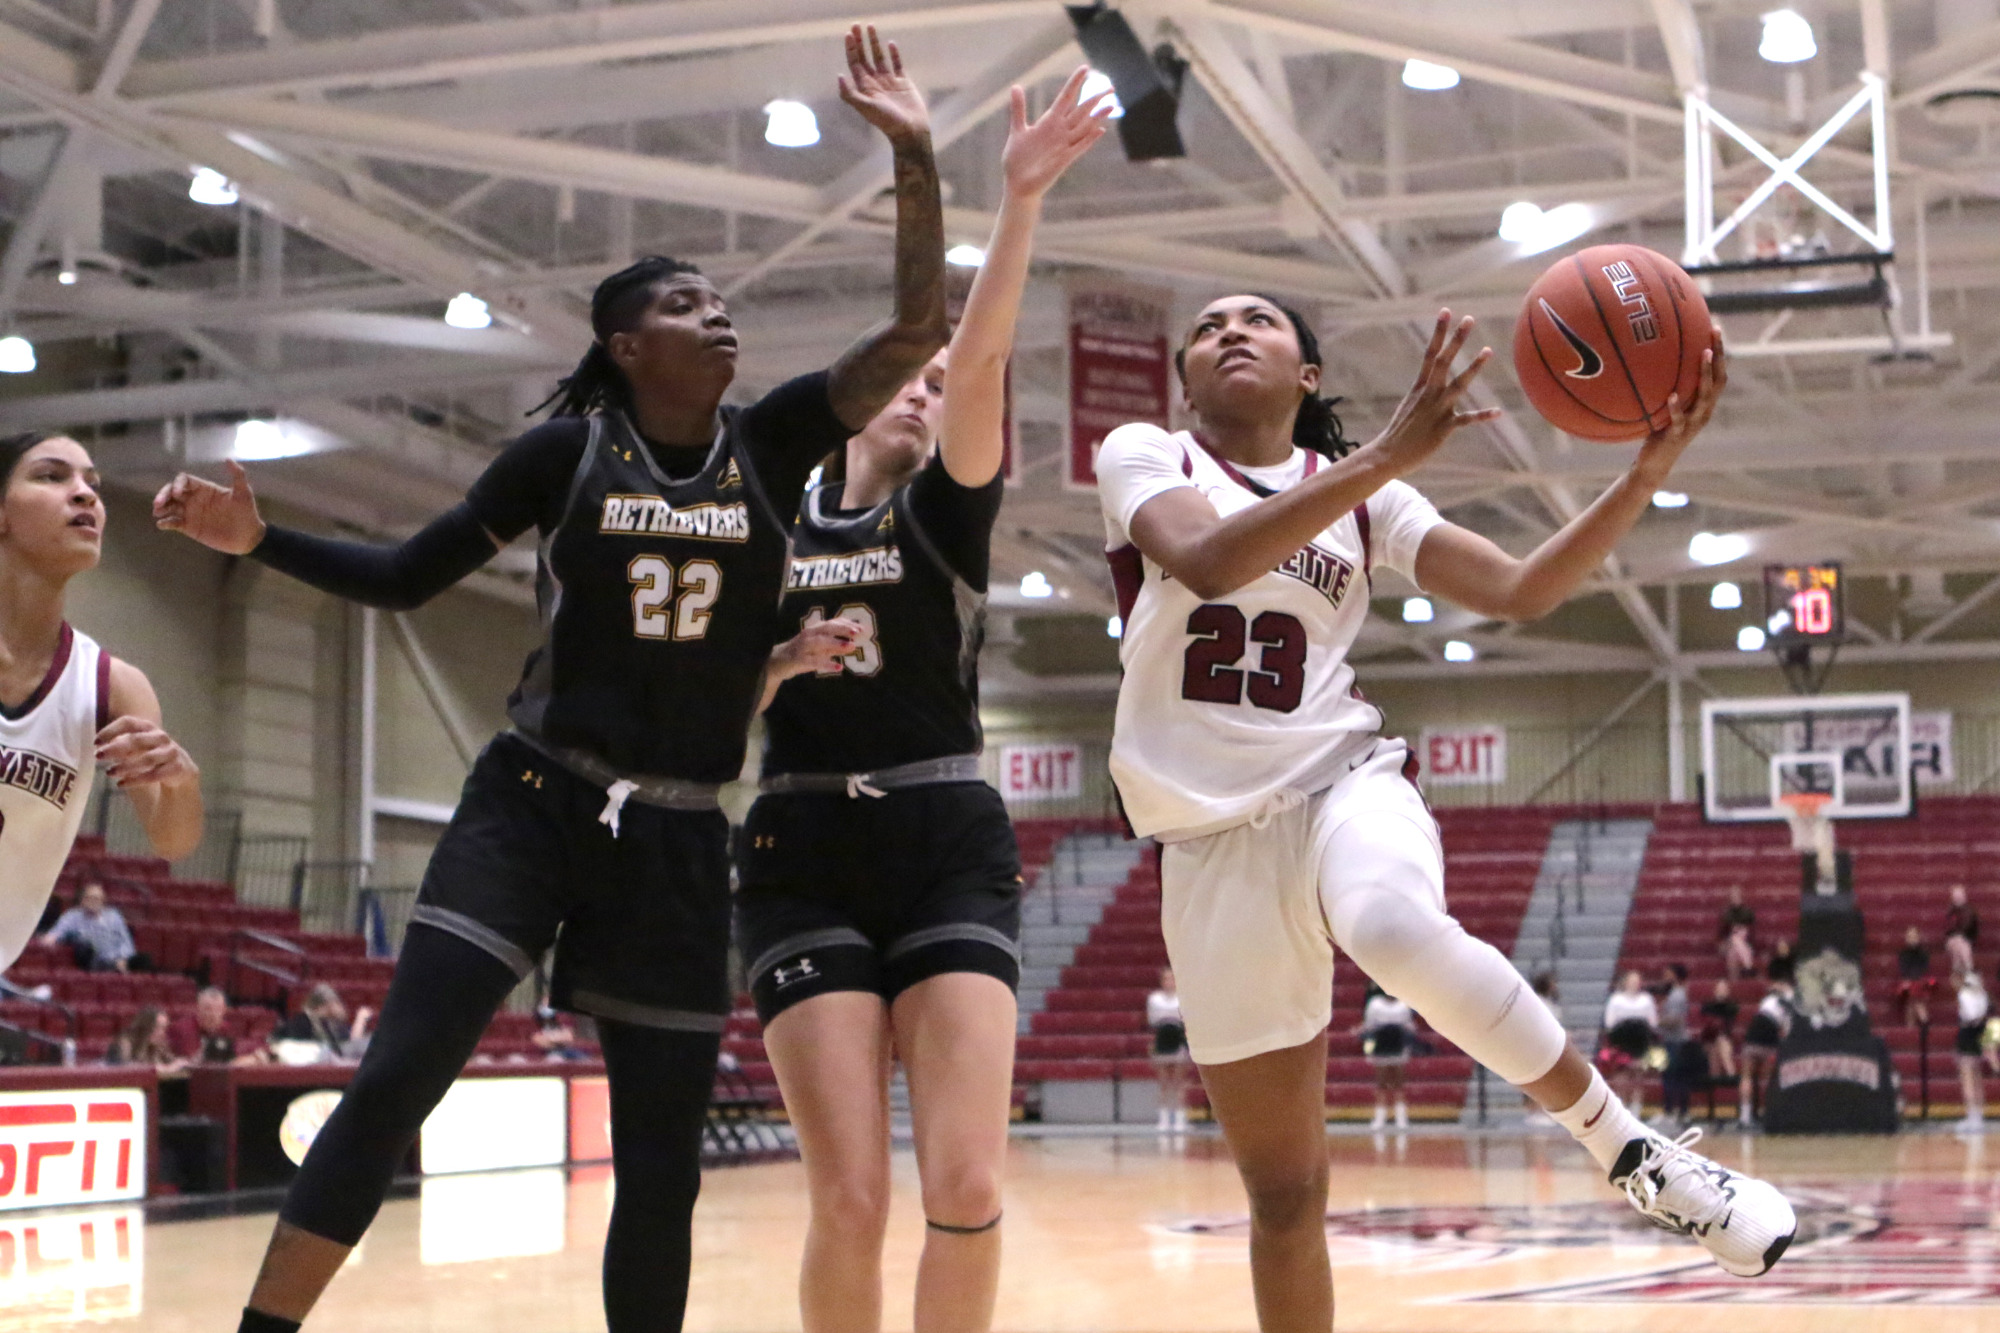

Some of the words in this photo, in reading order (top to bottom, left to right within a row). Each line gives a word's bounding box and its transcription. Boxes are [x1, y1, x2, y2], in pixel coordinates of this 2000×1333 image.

[1602, 261, 1656, 345] ELITE
[600, 494, 749, 542] RETRIEVERS
[786, 546, 903, 592] ETRIEVERS
[628, 554, 723, 641] 22
[1790, 588, 1831, 634] 10
[1181, 603, 1307, 713] 23
[1010, 750, 1075, 790] EXIT
[1429, 735, 1495, 775] EXIT
